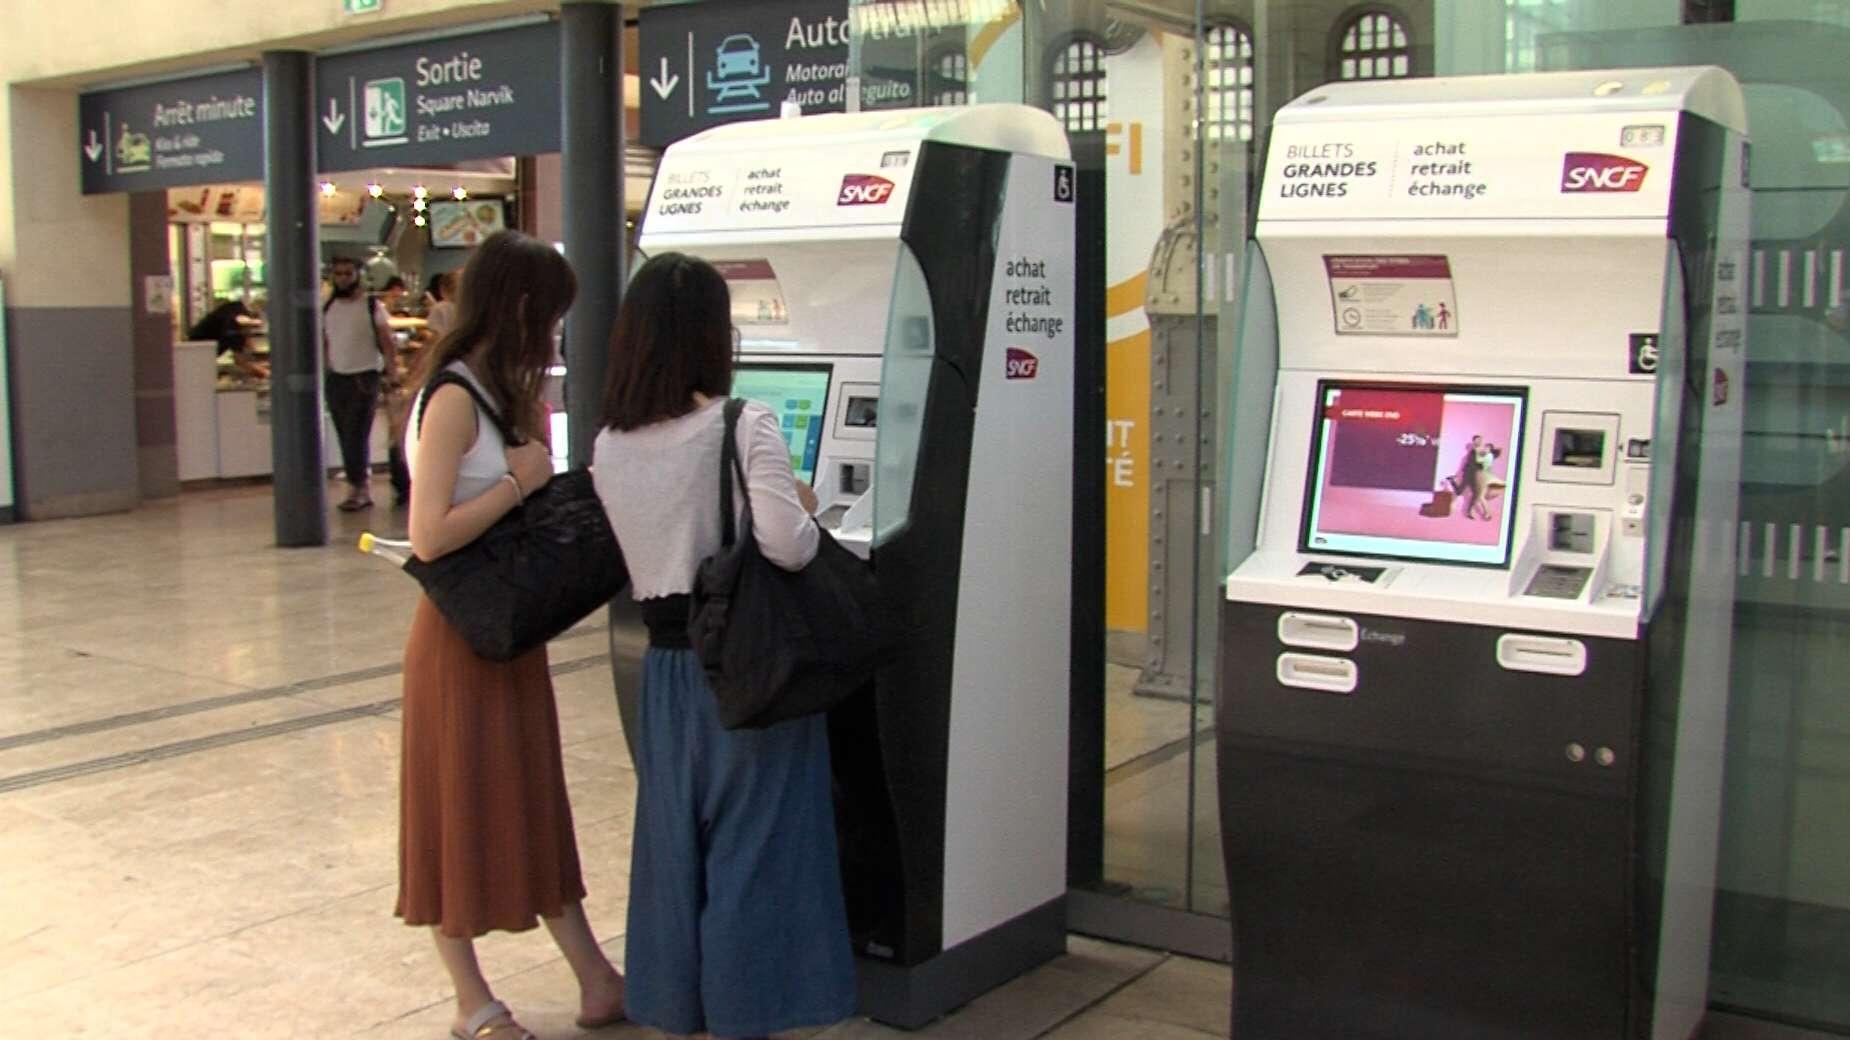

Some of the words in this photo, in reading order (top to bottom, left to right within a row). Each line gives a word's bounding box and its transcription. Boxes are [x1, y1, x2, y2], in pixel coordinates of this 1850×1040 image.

[416, 52, 483, 87] Sortie
[416, 92, 463, 116] Square
[467, 85, 514, 107] Narvik
[786, 86, 825, 107] Auto
[828, 83, 845, 103] al
[861, 79, 911, 105] guito
[154, 101, 195, 128] Arrêt
[196, 95, 256, 121] minute
[417, 123, 441, 142] Exit
[452, 120, 490, 139] Uscita
[1286, 143, 1354, 160] BILLETS
[1413, 140, 1466, 156] achat
[748, 167, 781, 180] achat
[1283, 161, 1377, 179] GRANDES
[1411, 159, 1472, 176] retrait
[1564, 165, 1646, 189] SNCF
[663, 185, 723, 200] GRANDES
[744, 182, 783, 196] retrait
[839, 183, 891, 204] SNCF
[1280, 182, 1348, 198] LIGNES
[1407, 180, 1487, 199] échange
[659, 201, 702, 216] LIGNES
[740, 198, 790, 213] échange
[1006, 257, 1046, 279] achat
[1006, 285, 1051, 306] retrait
[1006, 311, 1063, 340] échange
[1007, 359, 1036, 377] SNCF
[1105, 451, 1135, 487] É
